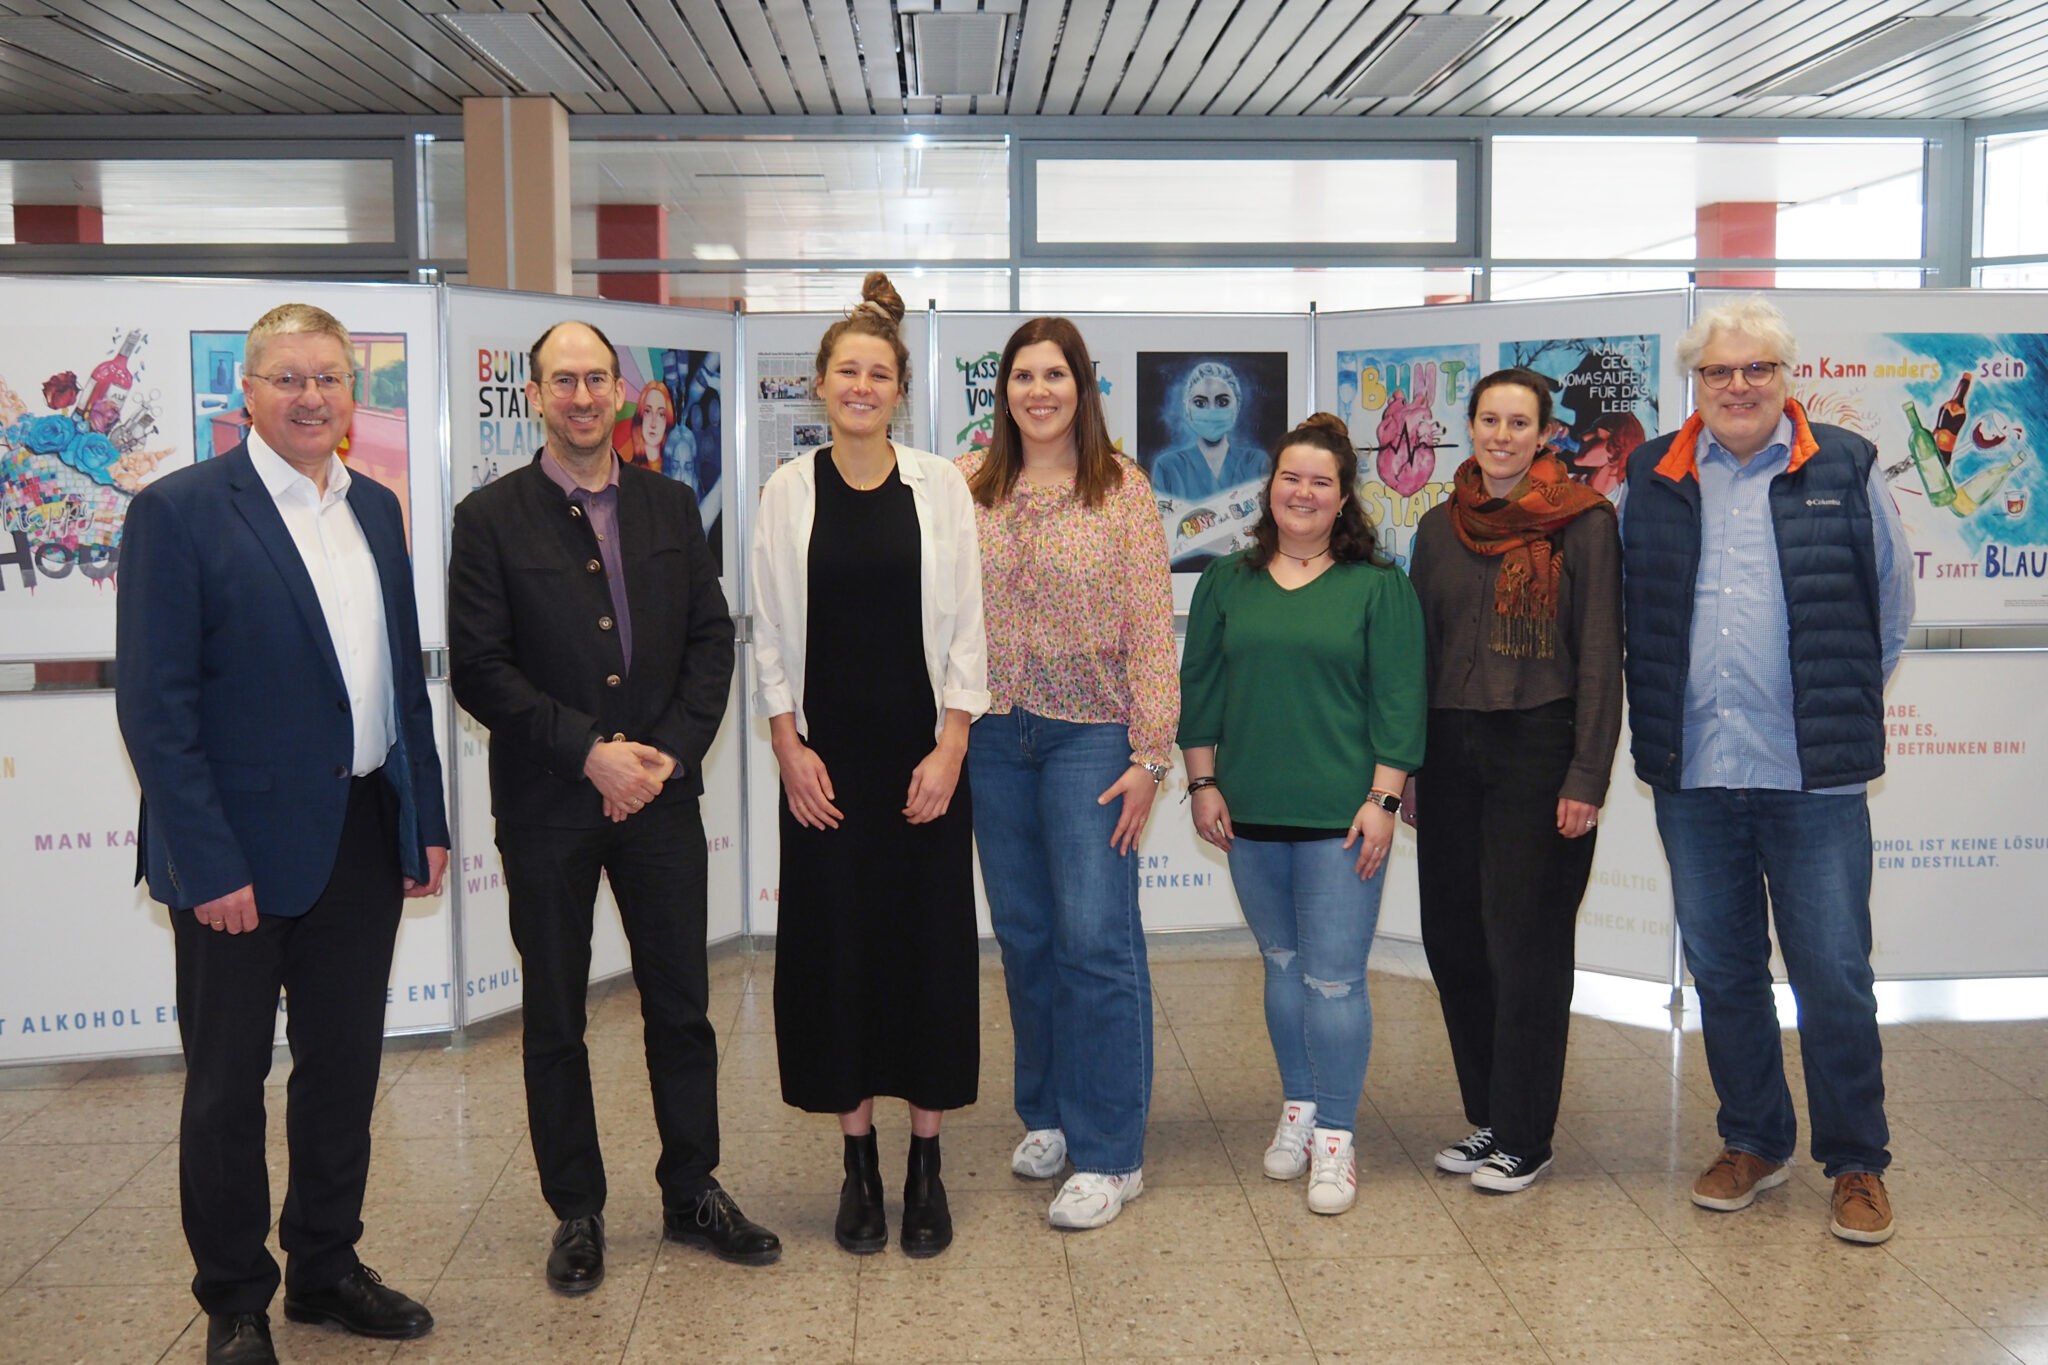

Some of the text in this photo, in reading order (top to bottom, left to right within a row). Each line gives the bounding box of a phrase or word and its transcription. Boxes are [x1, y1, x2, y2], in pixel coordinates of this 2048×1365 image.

[478, 348, 532, 383] BUN
[1601, 356, 1651, 369] GEGEN
[1873, 357, 1940, 380] anders
[1980, 357, 2026, 379] sein
[1361, 361, 1466, 412] BUNT
[1558, 371, 1651, 388] KOMASAUFEN
[478, 386, 543, 418] STAT
[1621, 385, 1650, 399] DAS
[479, 420, 542, 456] BLAU
[1936, 563, 1979, 578] STATT
[1985, 544, 2048, 578] BLAU
[1897, 741, 1988, 756] BETRUNKEN
[1993, 741, 2027, 755] BIN!
[34, 832, 92, 851] MAN
[1919, 838, 1946, 852] IST
[1951, 838, 1999, 851] KEINE
[2004, 834, 2048, 850] LÖSU
[1877, 855, 2000, 869] EIN DESTILLAT.
[22, 1008, 142, 1035] ALKOHOL
